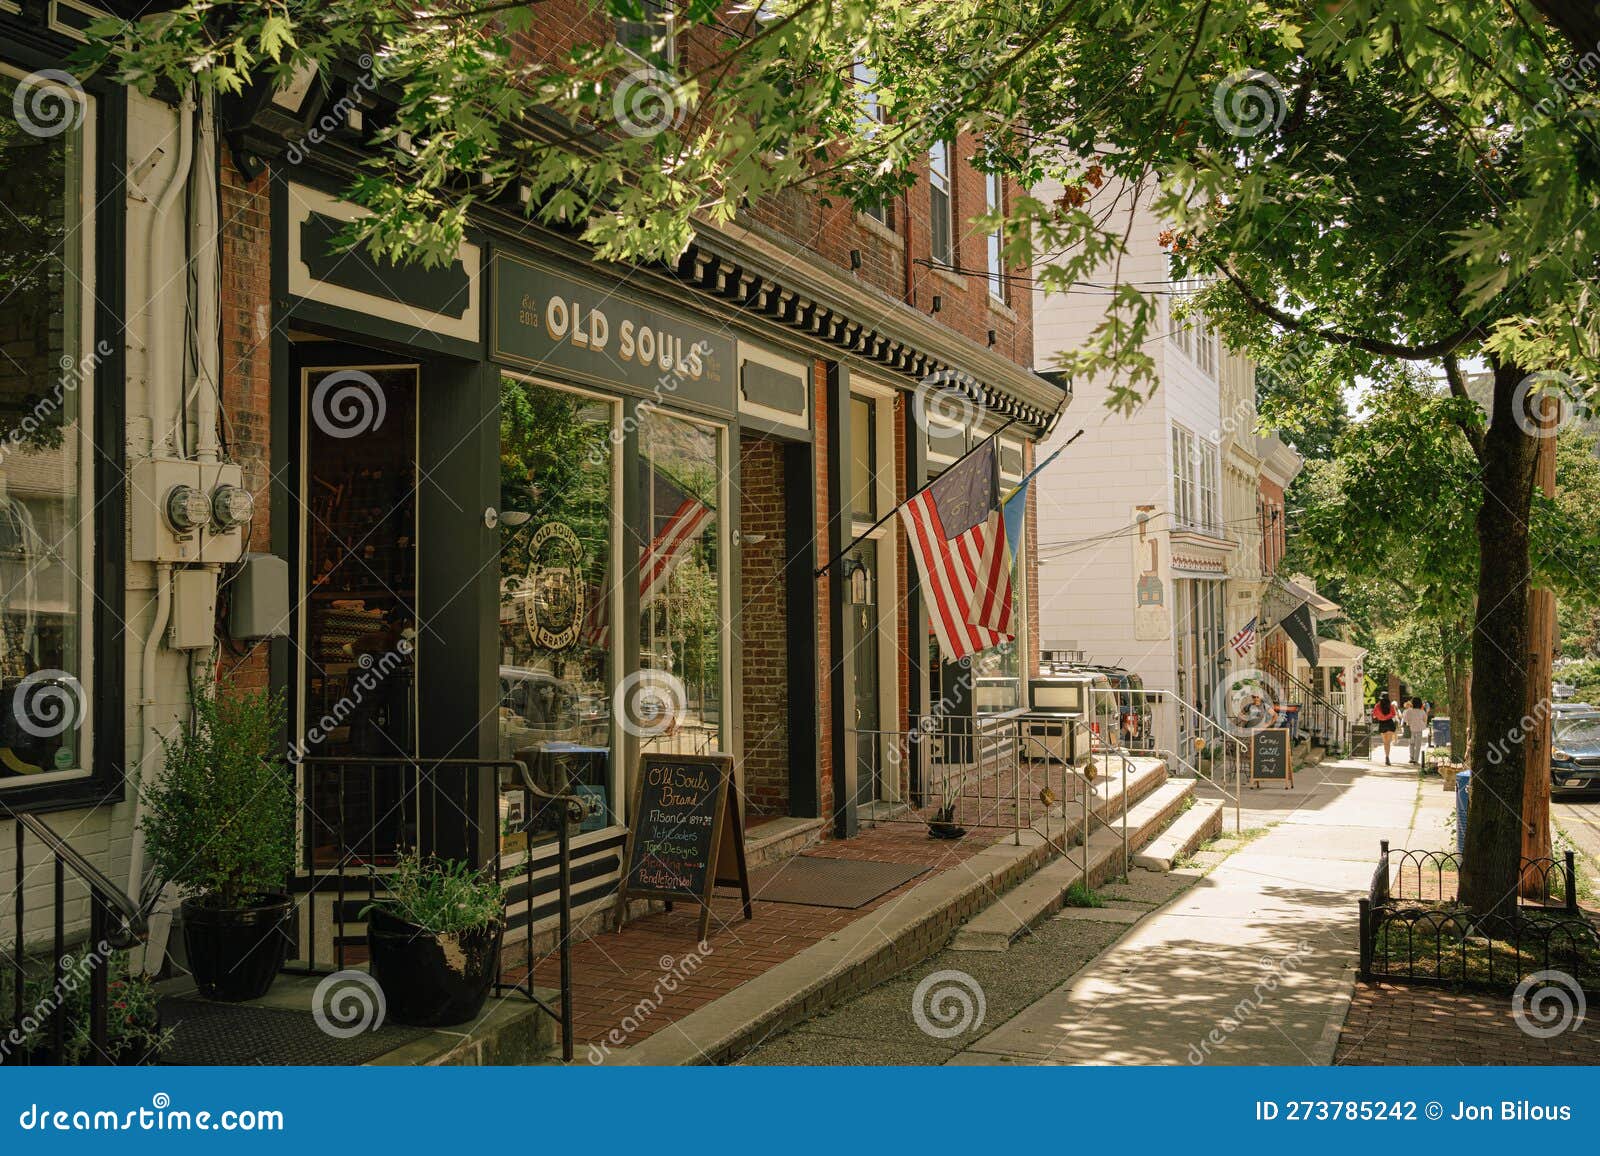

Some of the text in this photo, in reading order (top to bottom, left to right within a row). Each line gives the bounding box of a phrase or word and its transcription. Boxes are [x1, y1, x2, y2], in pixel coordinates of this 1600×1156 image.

[546, 295, 609, 352] OLD
[619, 319, 703, 382] SOULS
[536, 523, 577, 544] OLD SOULS
[543, 631, 570, 646] BRAND
[648, 767, 710, 792] Old Souls
[659, 786, 698, 807] Brand
[662, 841, 698, 859] Designs
[639, 868, 677, 885] Pendleton
